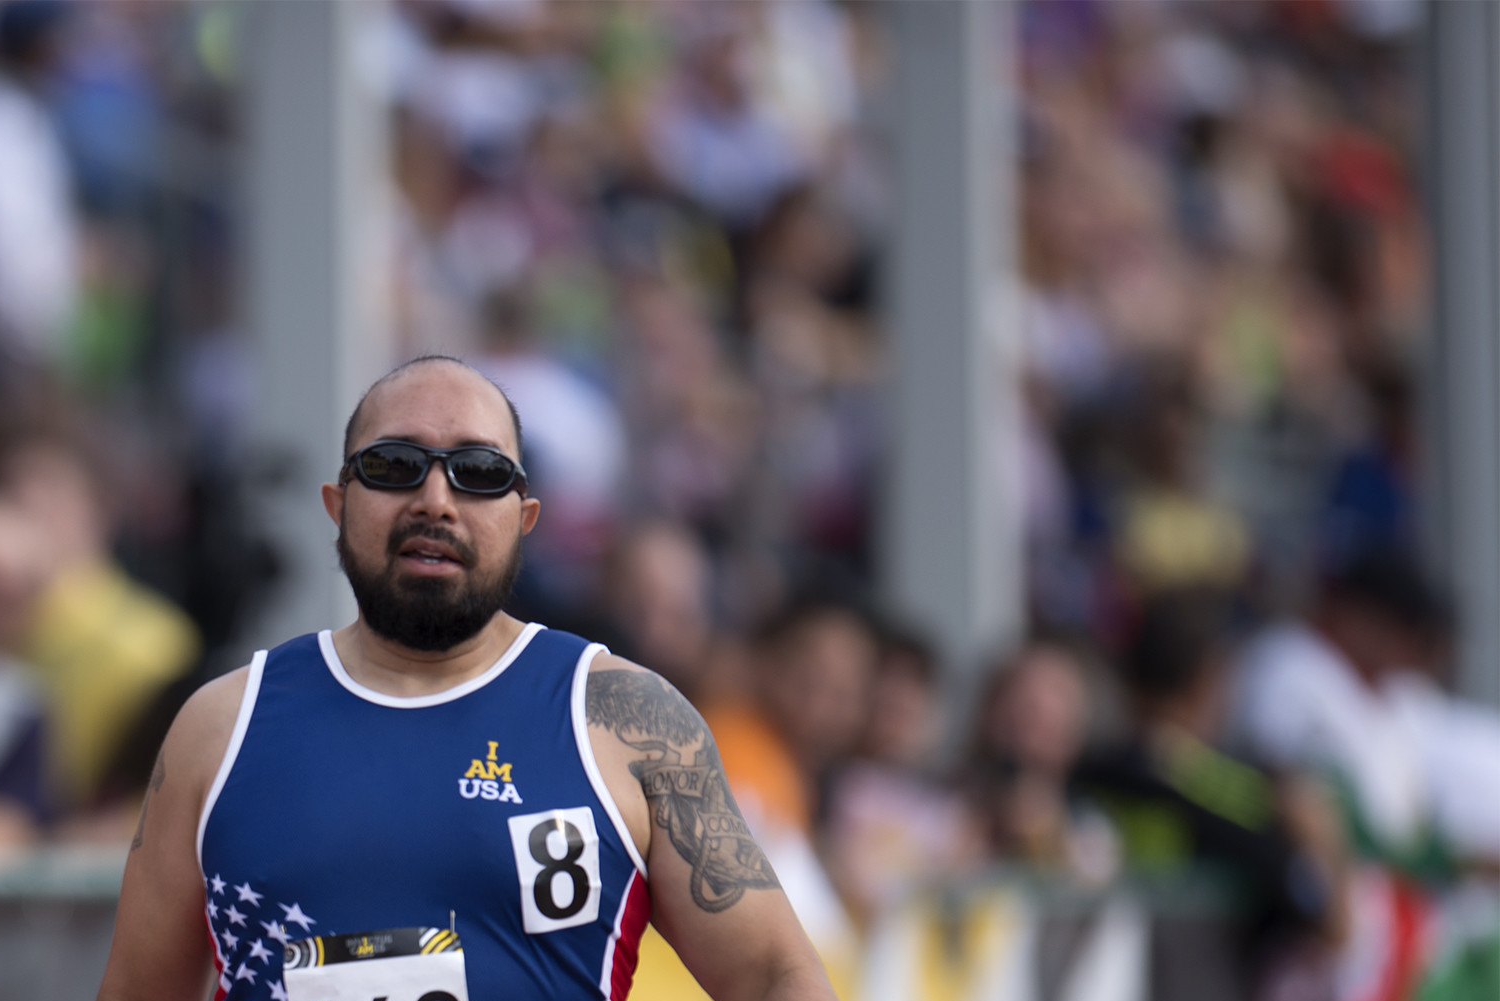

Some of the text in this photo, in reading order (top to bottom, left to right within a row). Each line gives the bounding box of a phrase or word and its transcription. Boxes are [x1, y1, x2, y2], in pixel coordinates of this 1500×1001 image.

[486, 740, 499, 761] I
[464, 759, 513, 782] AM
[644, 770, 699, 793] HONOR
[458, 778, 523, 804] USA
[528, 817, 591, 920] 8
